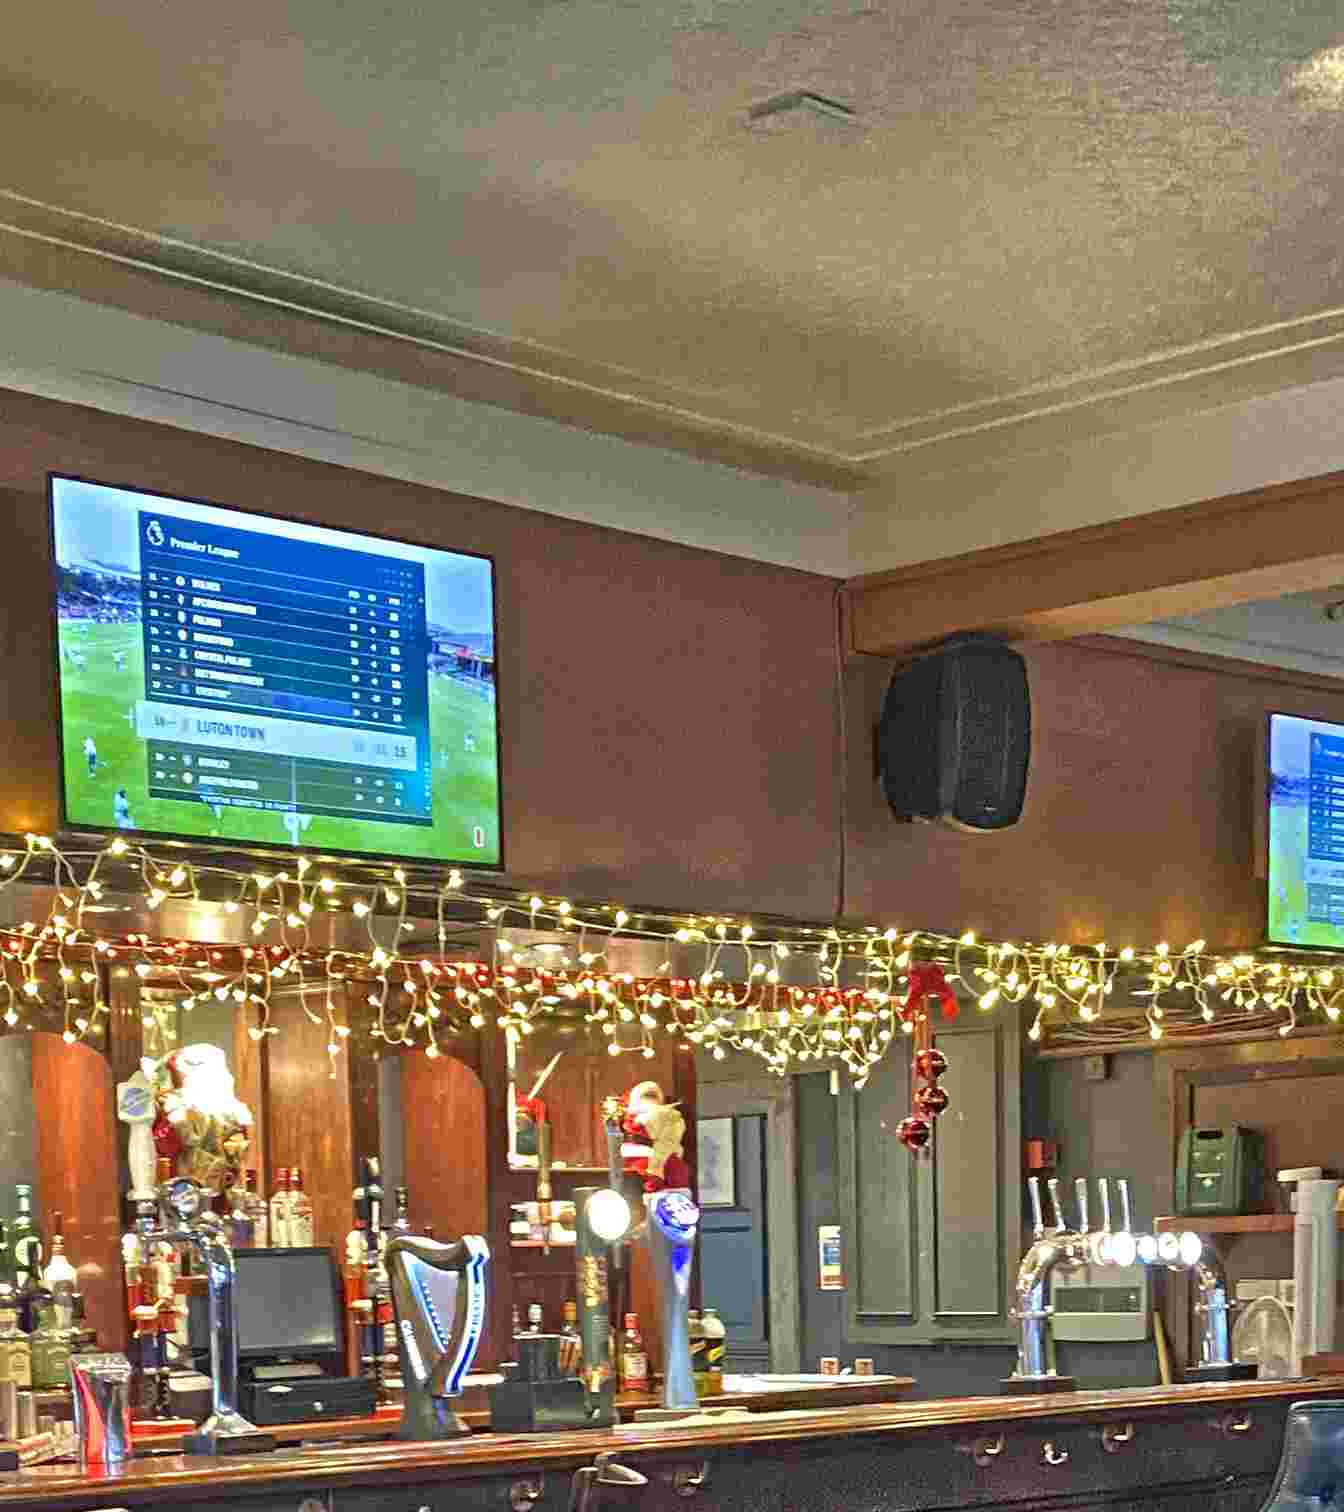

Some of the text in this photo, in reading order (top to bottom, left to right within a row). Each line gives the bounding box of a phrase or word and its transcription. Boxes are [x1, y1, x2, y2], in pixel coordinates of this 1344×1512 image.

[169, 536, 206, 553] Premier
[197, 718, 233, 737] LUTON
[234, 725, 265, 741] TOWN
